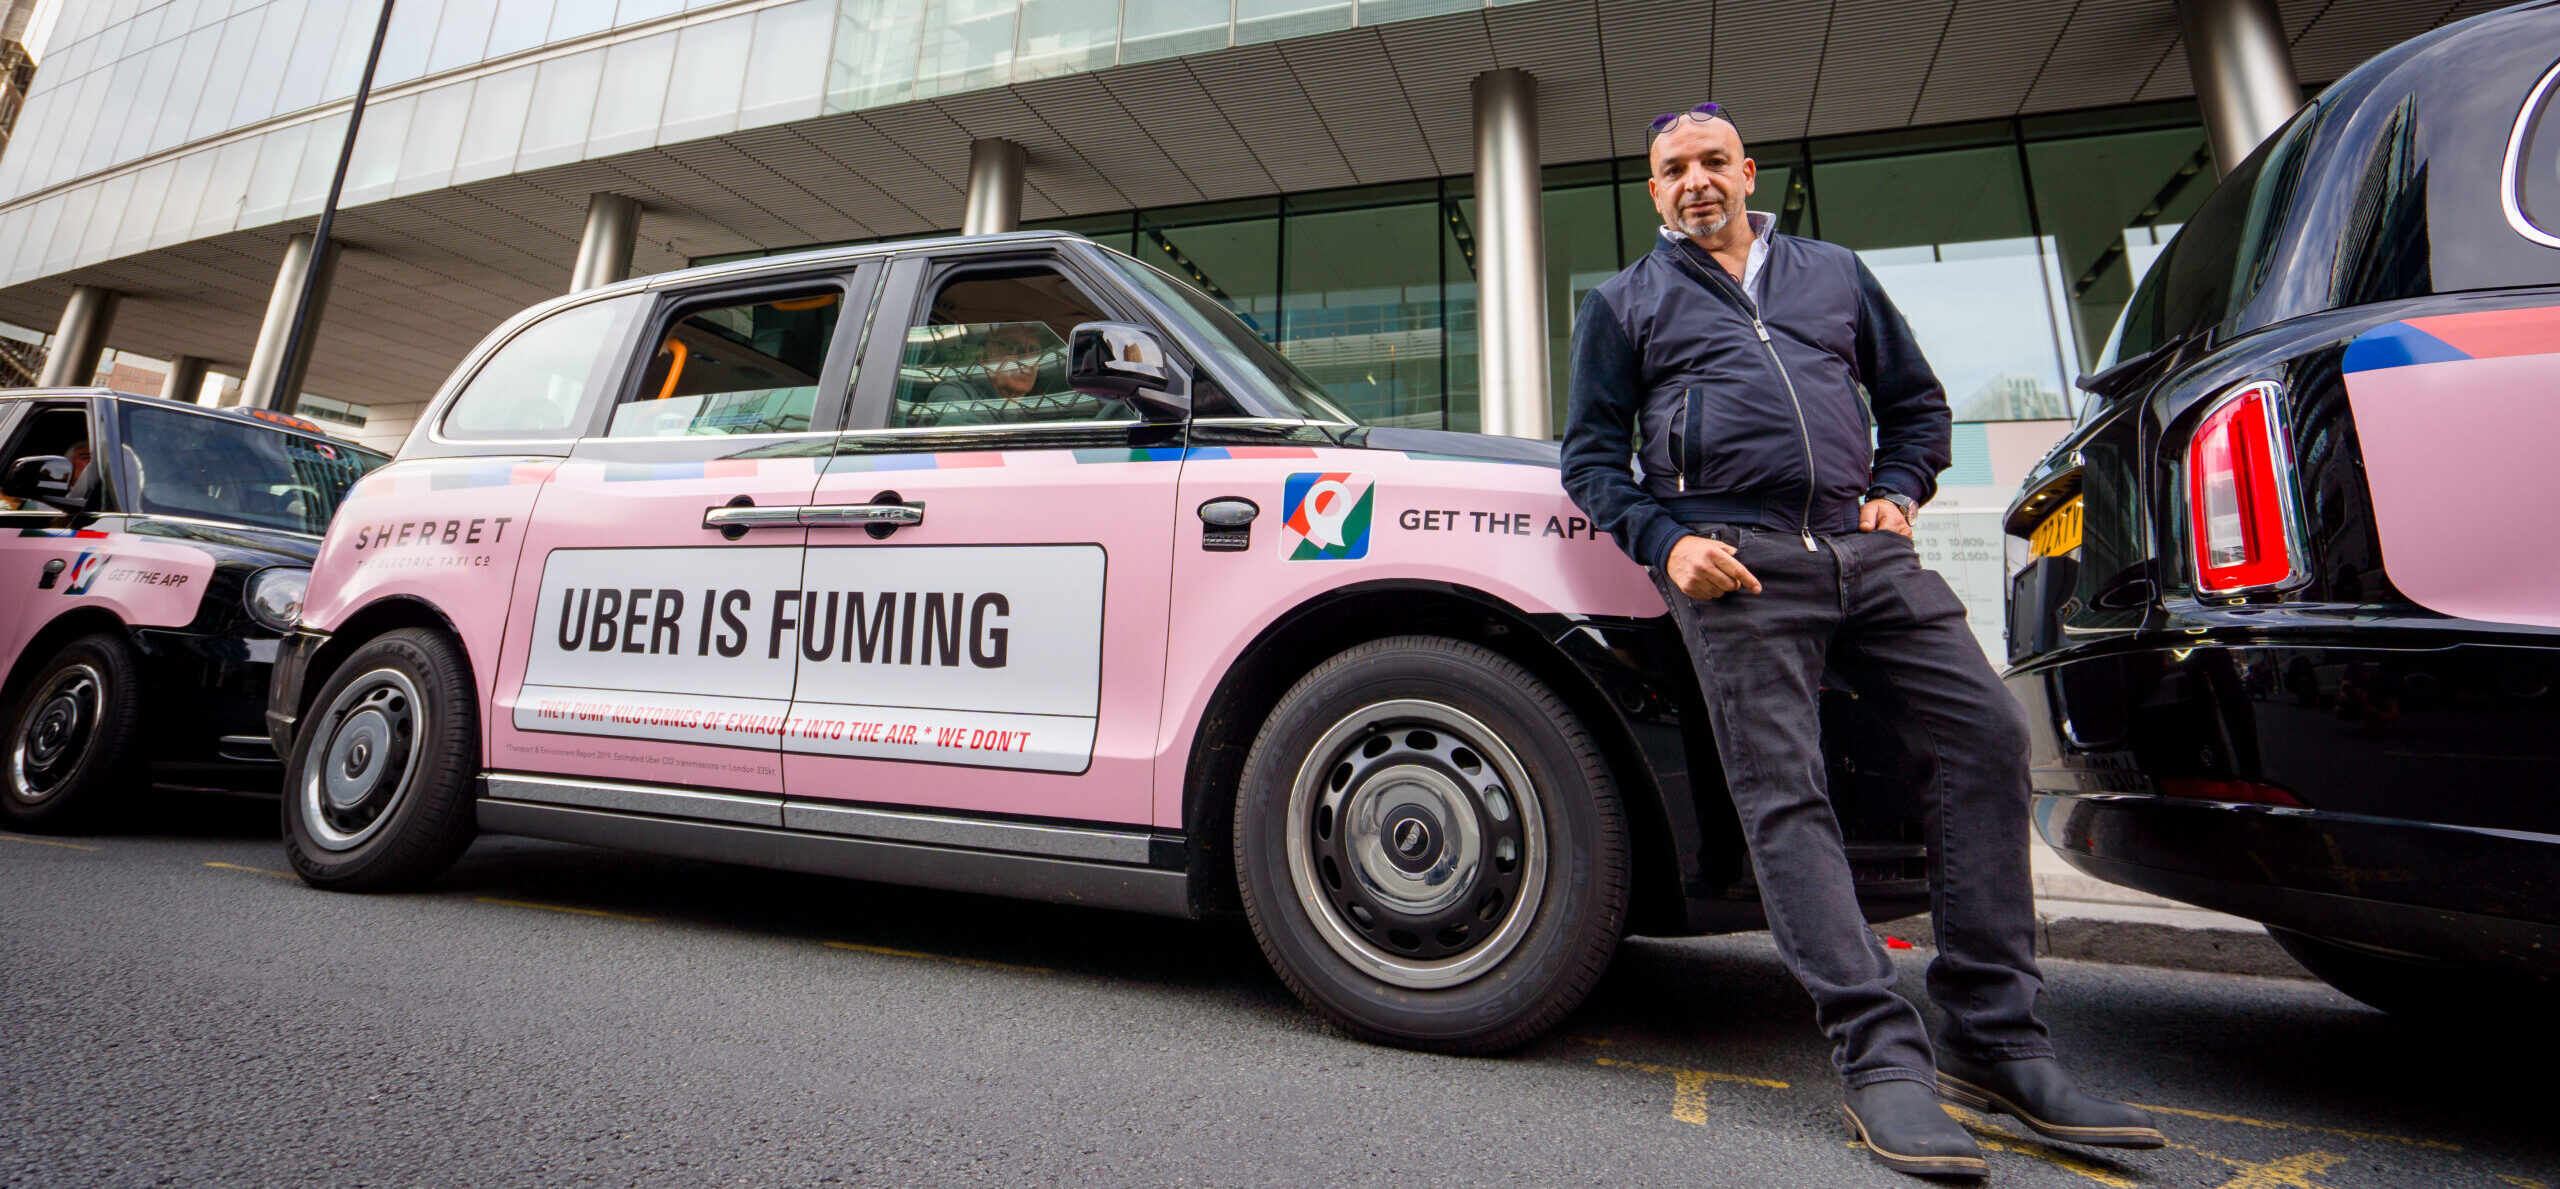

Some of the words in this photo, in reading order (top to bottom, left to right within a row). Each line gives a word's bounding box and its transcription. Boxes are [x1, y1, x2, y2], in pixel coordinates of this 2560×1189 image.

[355, 517, 512, 550] SHERBET
[1399, 509, 1460, 532] GET
[1469, 511, 1531, 536] THE
[439, 556, 468, 567] TAXI
[108, 569, 135, 582] GET
[134, 570, 161, 585] THE
[159, 574, 189, 588] APP
[558, 587, 684, 655] UBER
[698, 589, 751, 658] IS
[768, 590, 1010, 669] FUMING
[538, 700, 572, 719] THEY
[570, 701, 612, 722] PUMP
[612, 704, 702, 729] KILOTONNES
[703, 711, 726, 730] OF
[725, 712, 803, 737] EXHAUST
[803, 719, 845, 740] INTO
[849, 721, 883, 743] THE
[937, 727, 967, 749] WE
[970, 729, 1031, 752] DON'T
[728, 763, 755, 774] London
